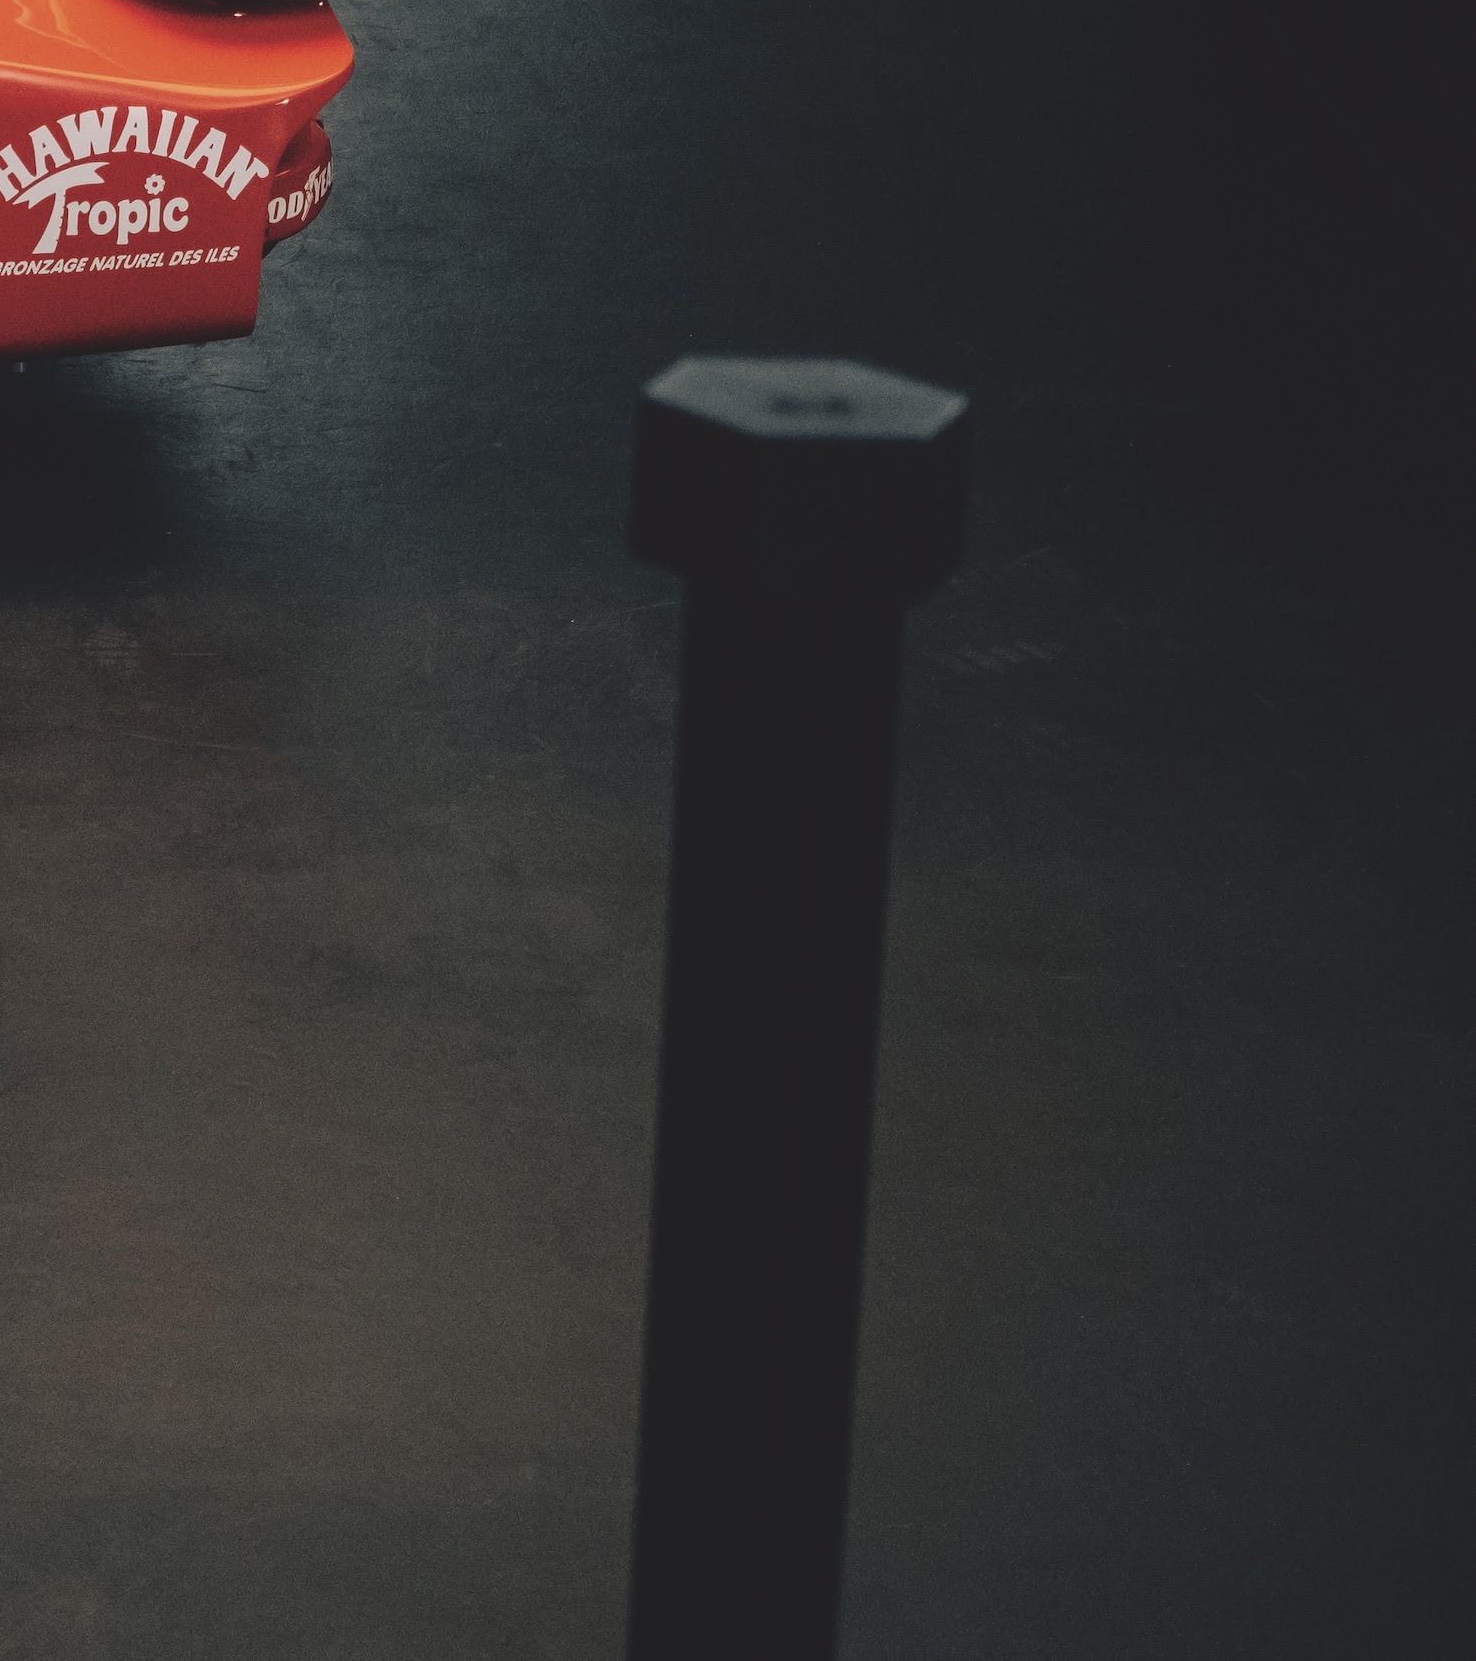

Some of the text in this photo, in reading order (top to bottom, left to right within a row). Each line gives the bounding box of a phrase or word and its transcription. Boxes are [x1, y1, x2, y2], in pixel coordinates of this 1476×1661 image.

[12, 162, 189, 254] Tropic
[267, 157, 334, 224] ODYEA
[89, 252, 166, 272] NATUREL
[169, 248, 202, 266] DES
[204, 245, 240, 264] ILES
